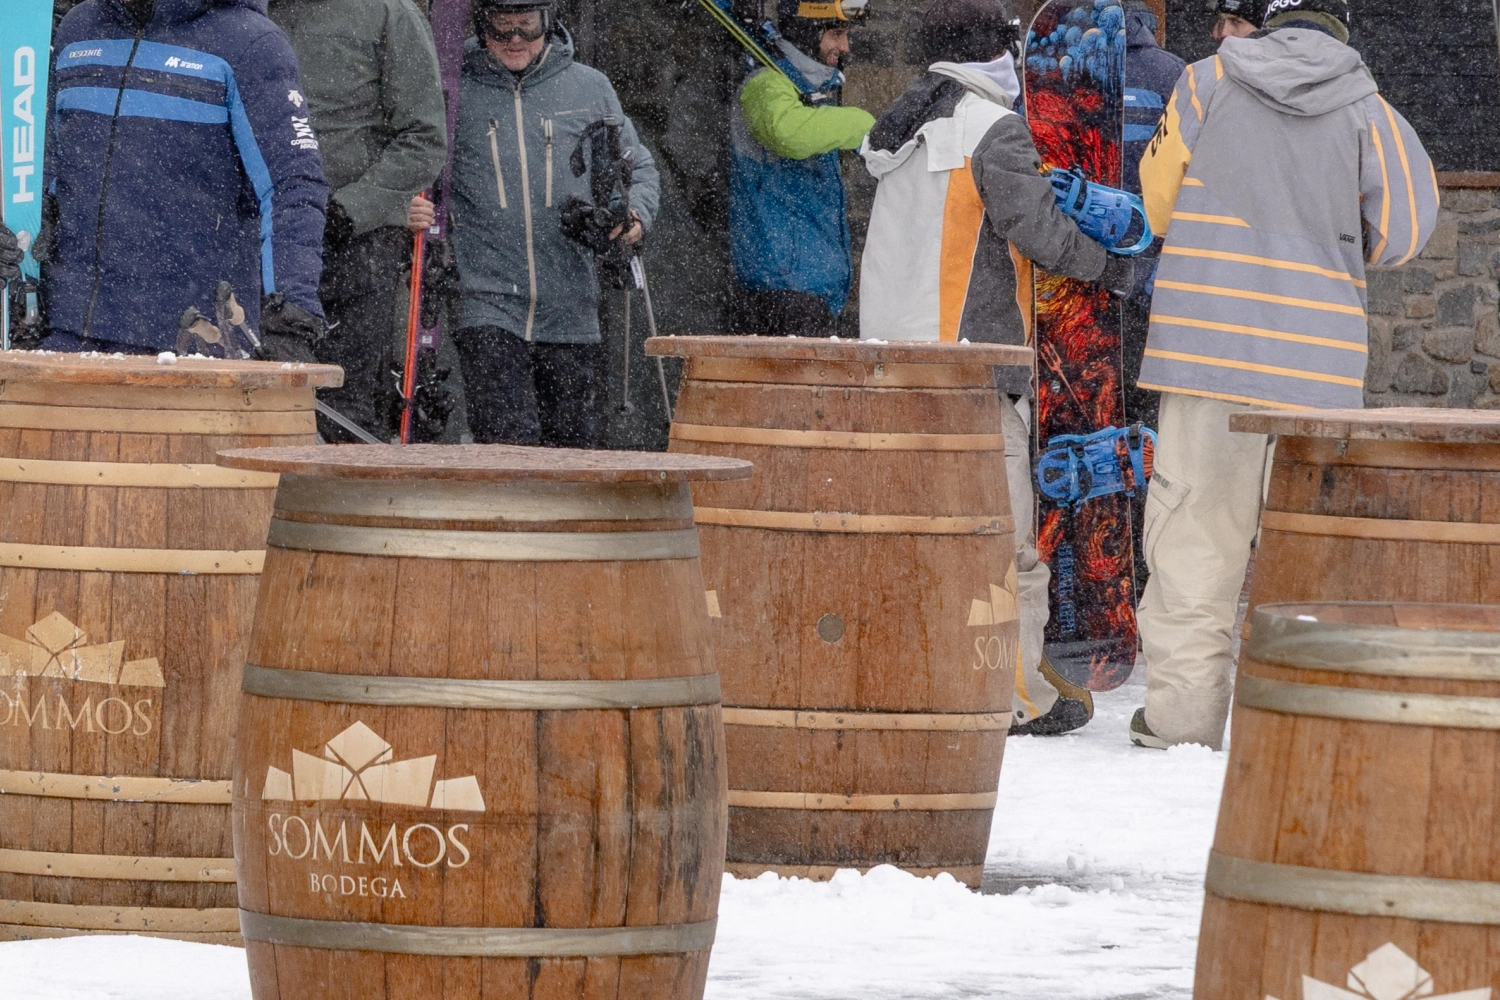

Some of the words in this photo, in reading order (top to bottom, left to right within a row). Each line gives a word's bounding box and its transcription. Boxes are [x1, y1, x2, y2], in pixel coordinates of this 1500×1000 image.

[68, 48, 103, 59] DESCENTE
[179, 60, 203, 70] aramon
[12, 46, 36, 204] HEAD
[268, 813, 471, 868] SOMMOS
[309, 872, 407, 899] BODEGA
